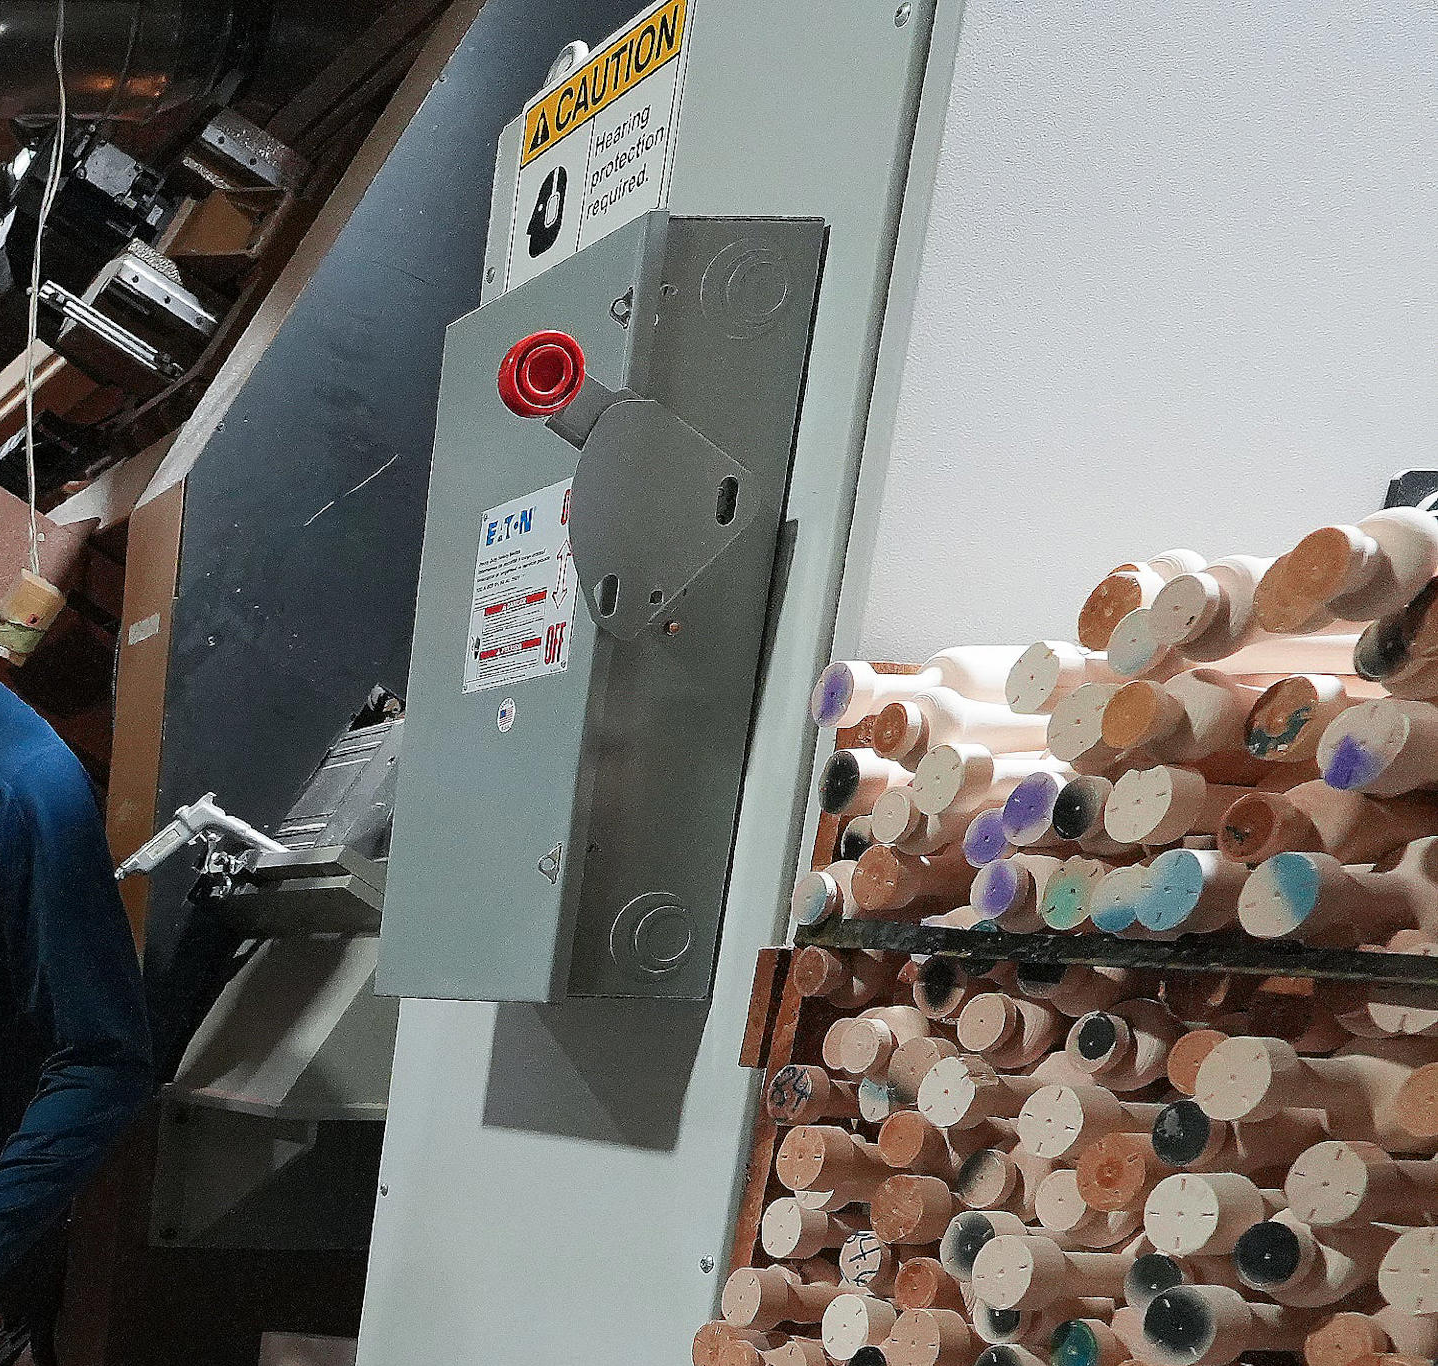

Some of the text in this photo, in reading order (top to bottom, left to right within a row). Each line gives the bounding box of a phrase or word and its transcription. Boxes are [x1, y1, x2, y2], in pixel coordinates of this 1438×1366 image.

[555, 5, 680, 132] CAUTION
[596, 105, 650, 153] Hearing
[590, 126, 664, 193] protection
[587, 165, 649, 217] required.
[544, 621, 567, 665] OFF
